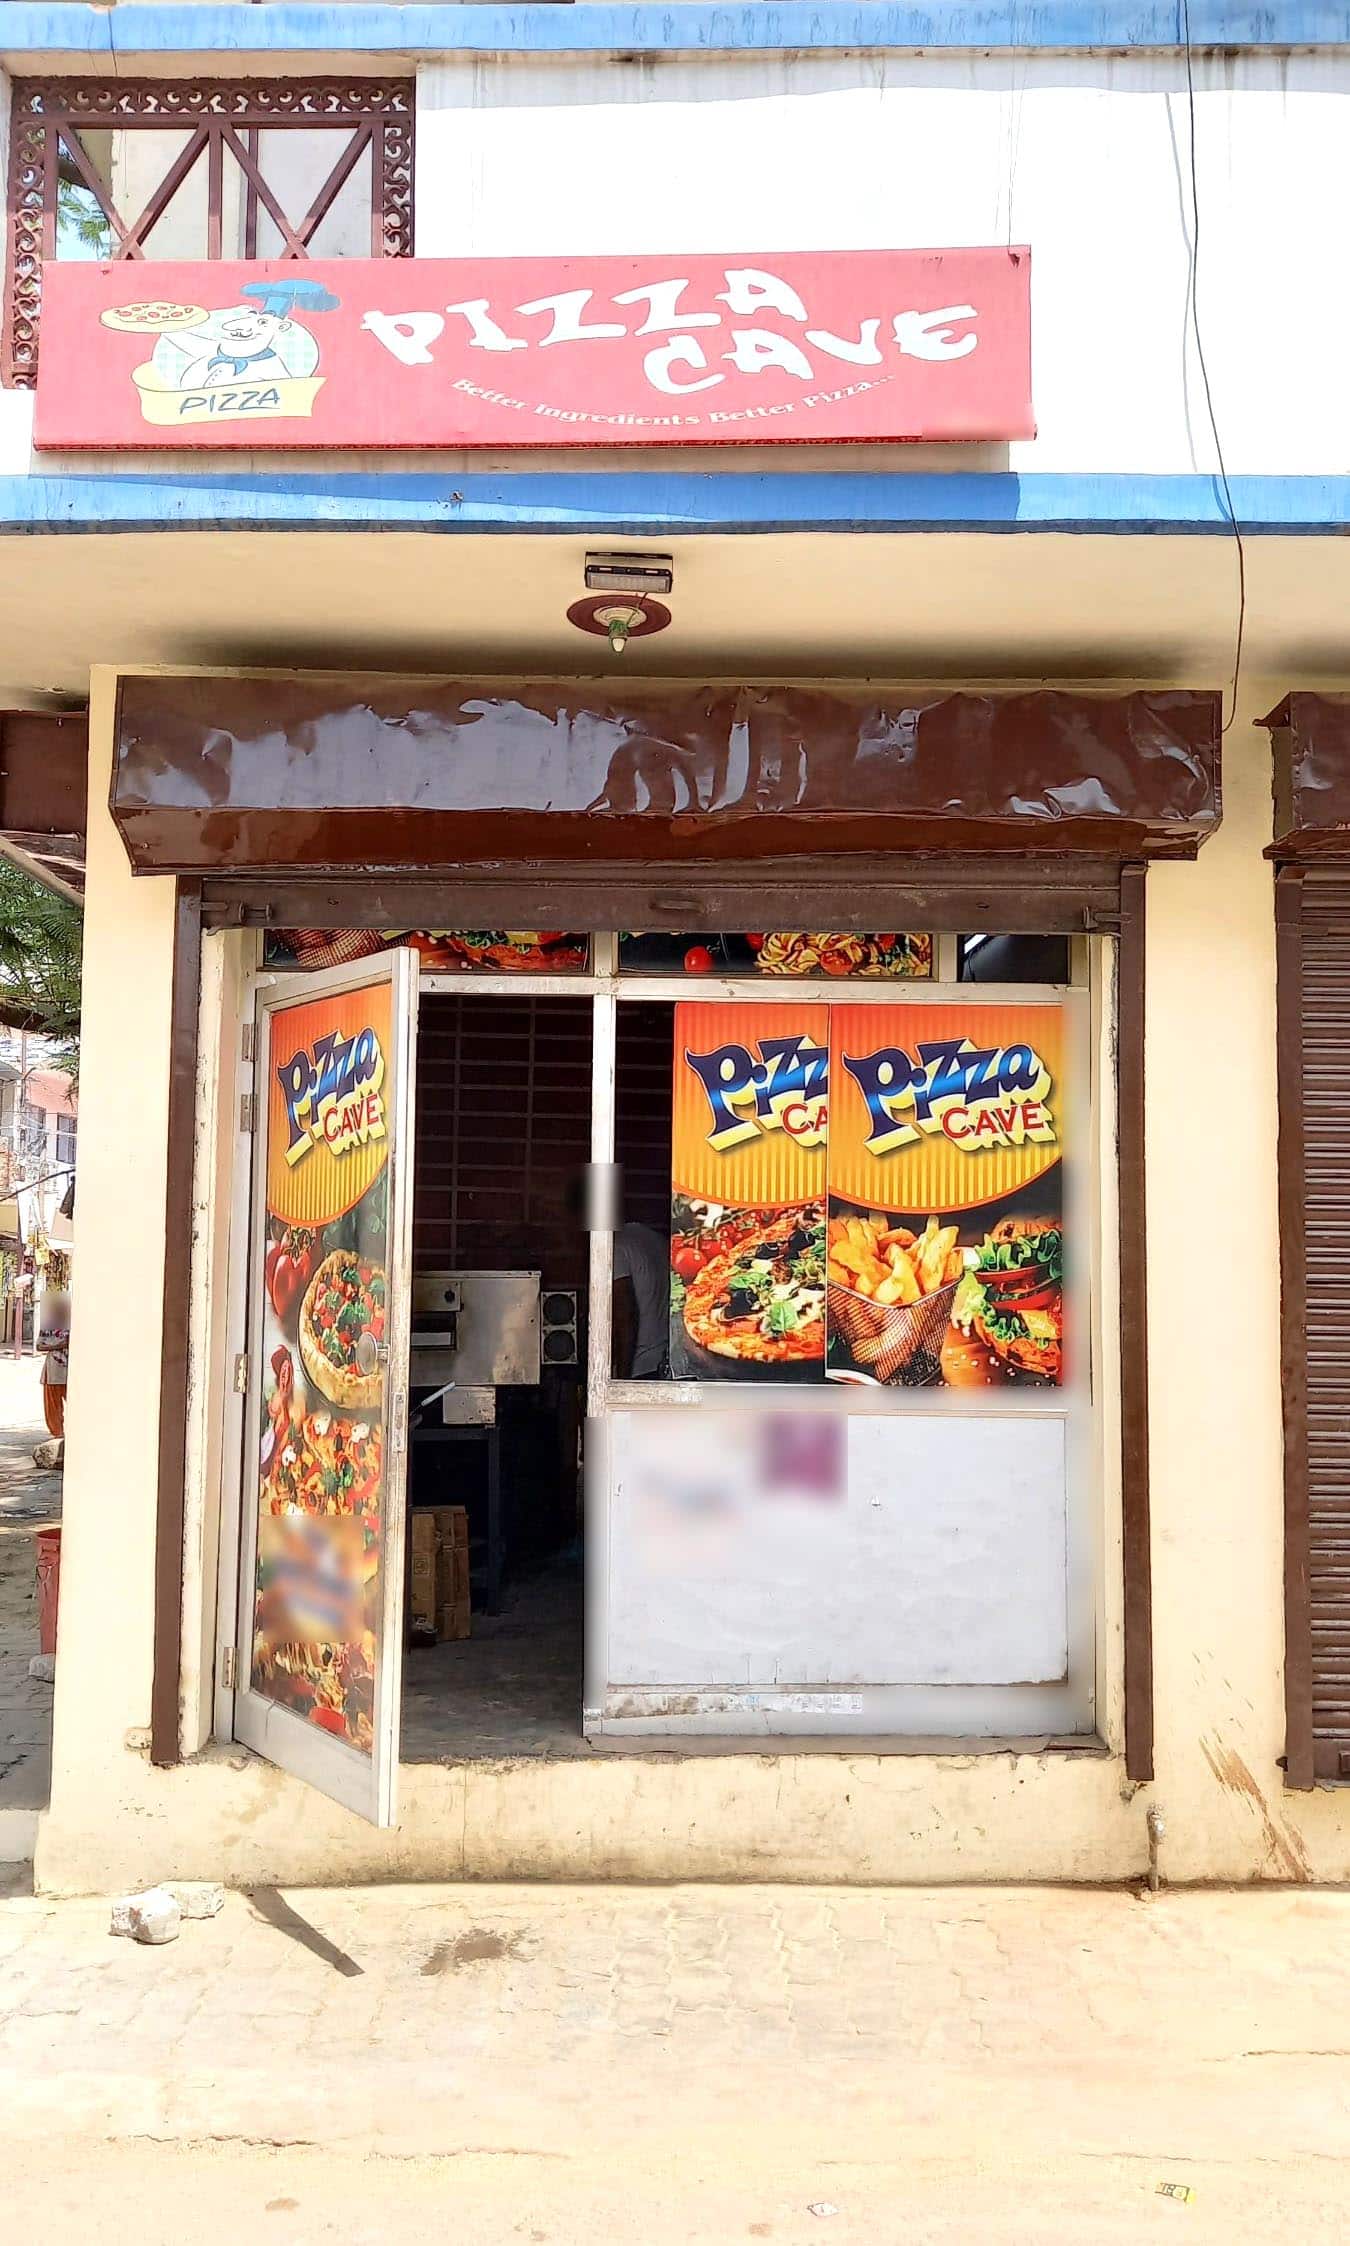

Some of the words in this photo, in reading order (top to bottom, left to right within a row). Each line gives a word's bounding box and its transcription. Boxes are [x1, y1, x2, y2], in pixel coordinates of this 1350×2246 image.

[361, 268, 808, 366] PIZZA
[643, 304, 979, 395] CAVE
[179, 387, 280, 414] PIZZA
[451, 379, 528, 409] Better
[708, 402, 796, 424] Better
[685, 1034, 828, 1139] Pizz
[842, 1038, 1040, 1142] Pizza
[323, 1093, 379, 1142] CAVE
[782, 1103, 828, 1135] CA
[942, 1102, 1045, 1139] CAVE
